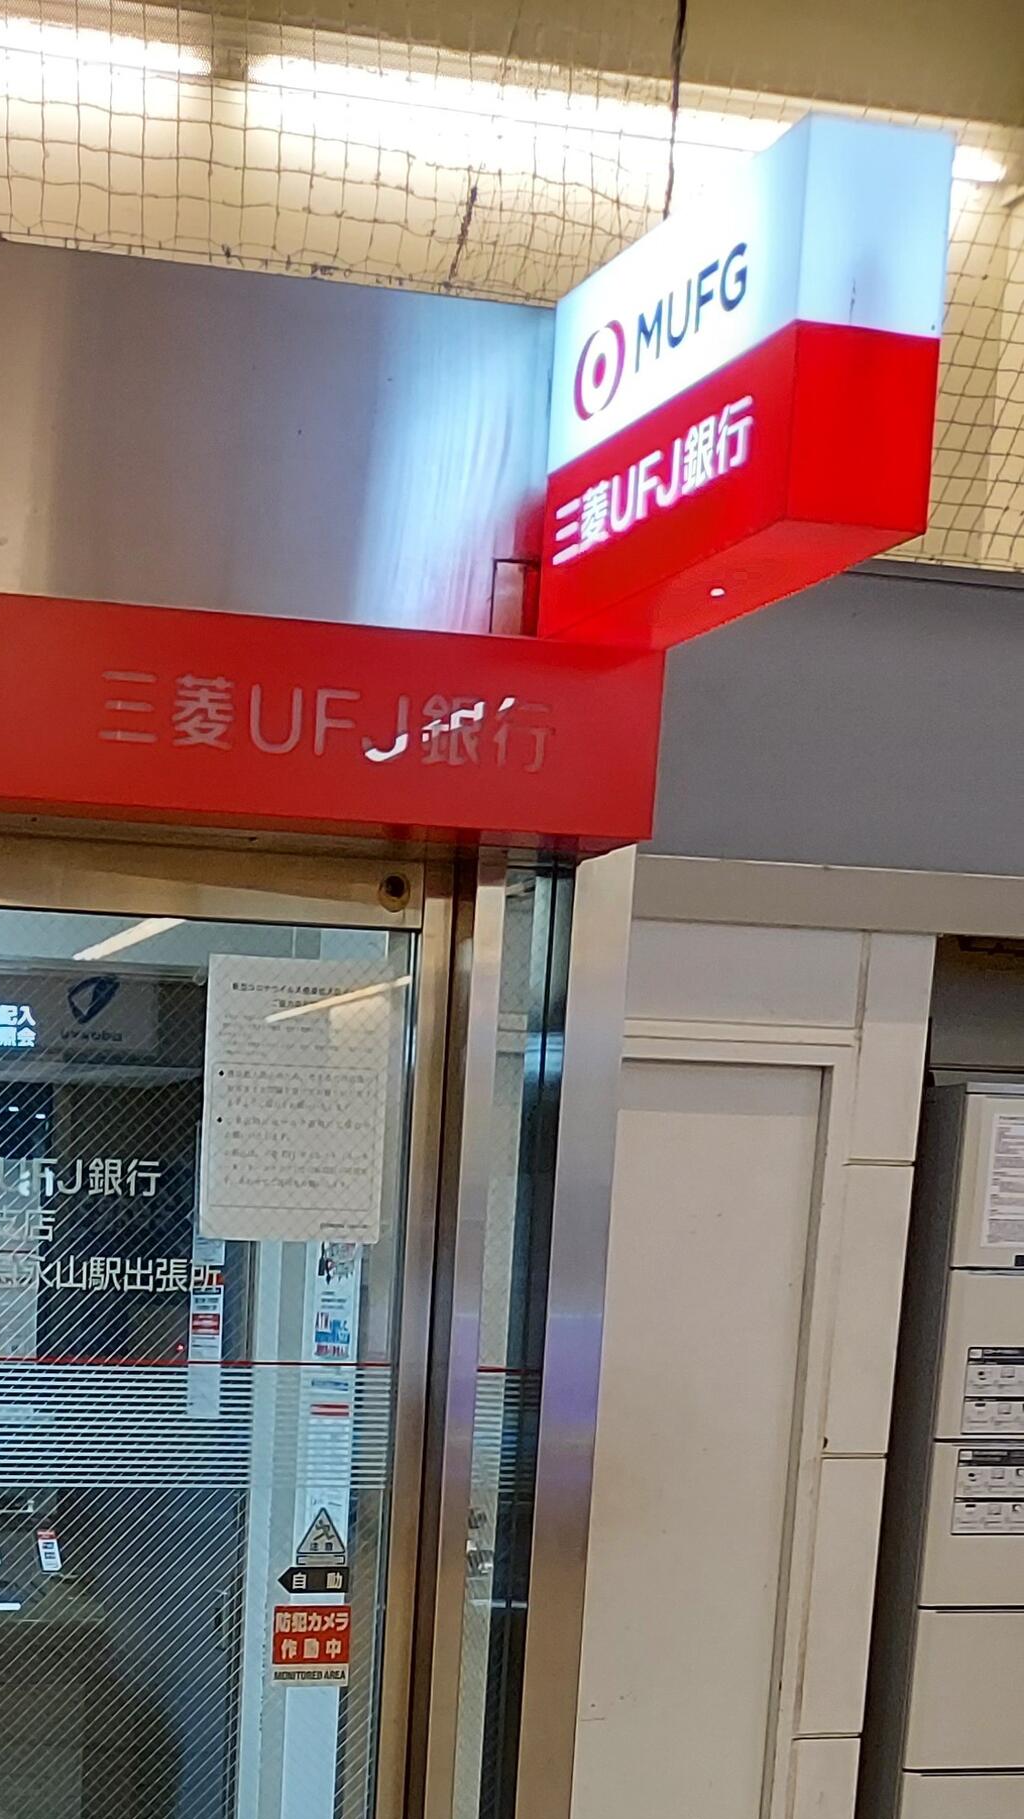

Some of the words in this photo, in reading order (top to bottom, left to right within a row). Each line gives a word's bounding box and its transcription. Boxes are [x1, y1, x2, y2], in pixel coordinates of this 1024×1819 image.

[634, 242, 749, 373] MUFG
[552, 396, 754, 566] 三菱UFJ銀行
[98, 669, 555, 773] 三菱UFJ銀行
[292, 1572, 344, 1590] 自動
[276, 1612, 350, 1633] 防犯カメラ
[281, 1638, 343, 1660] 作動中
[323, 1669, 347, 1680] AREA
